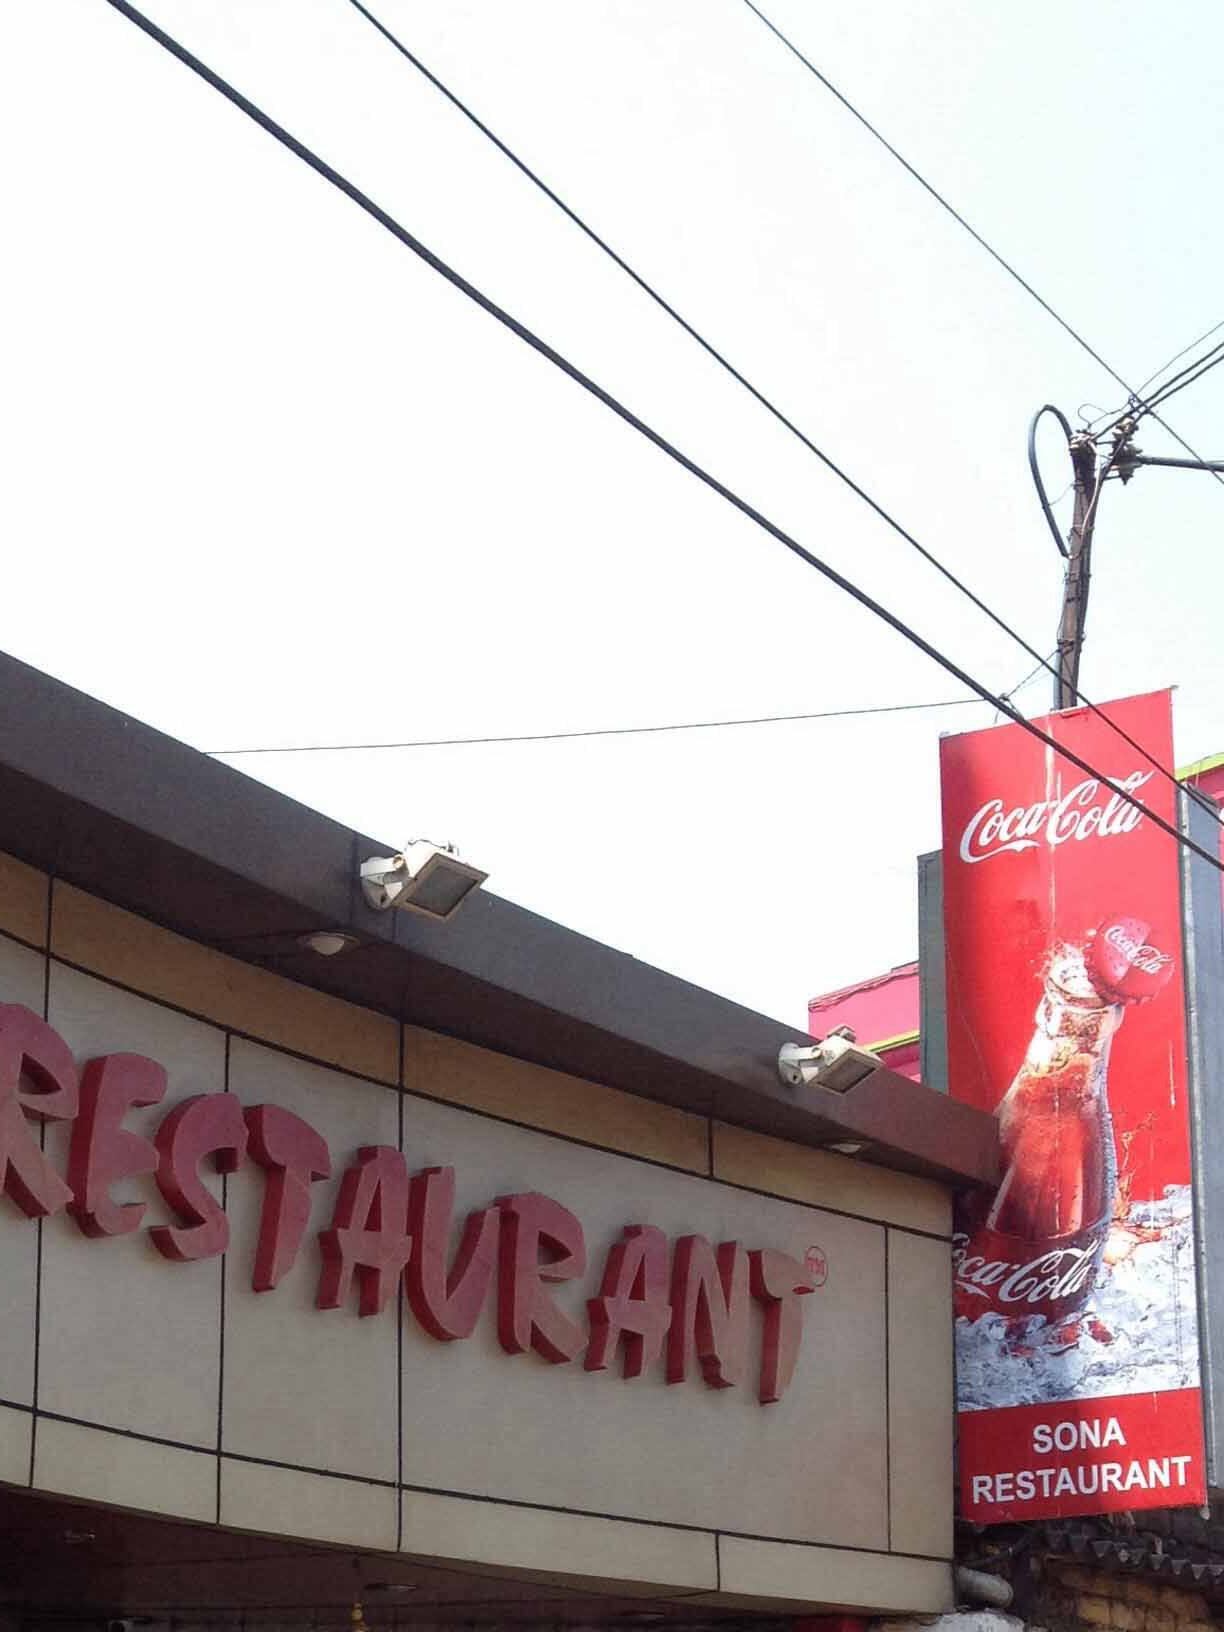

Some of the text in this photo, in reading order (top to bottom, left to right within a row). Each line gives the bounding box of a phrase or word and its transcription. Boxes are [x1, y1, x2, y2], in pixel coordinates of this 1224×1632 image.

[960, 771, 1155, 863] Coca-Cola
[1033, 1417, 1127, 1454] SONA
[971, 1455, 1193, 1504] RESTAURANT
